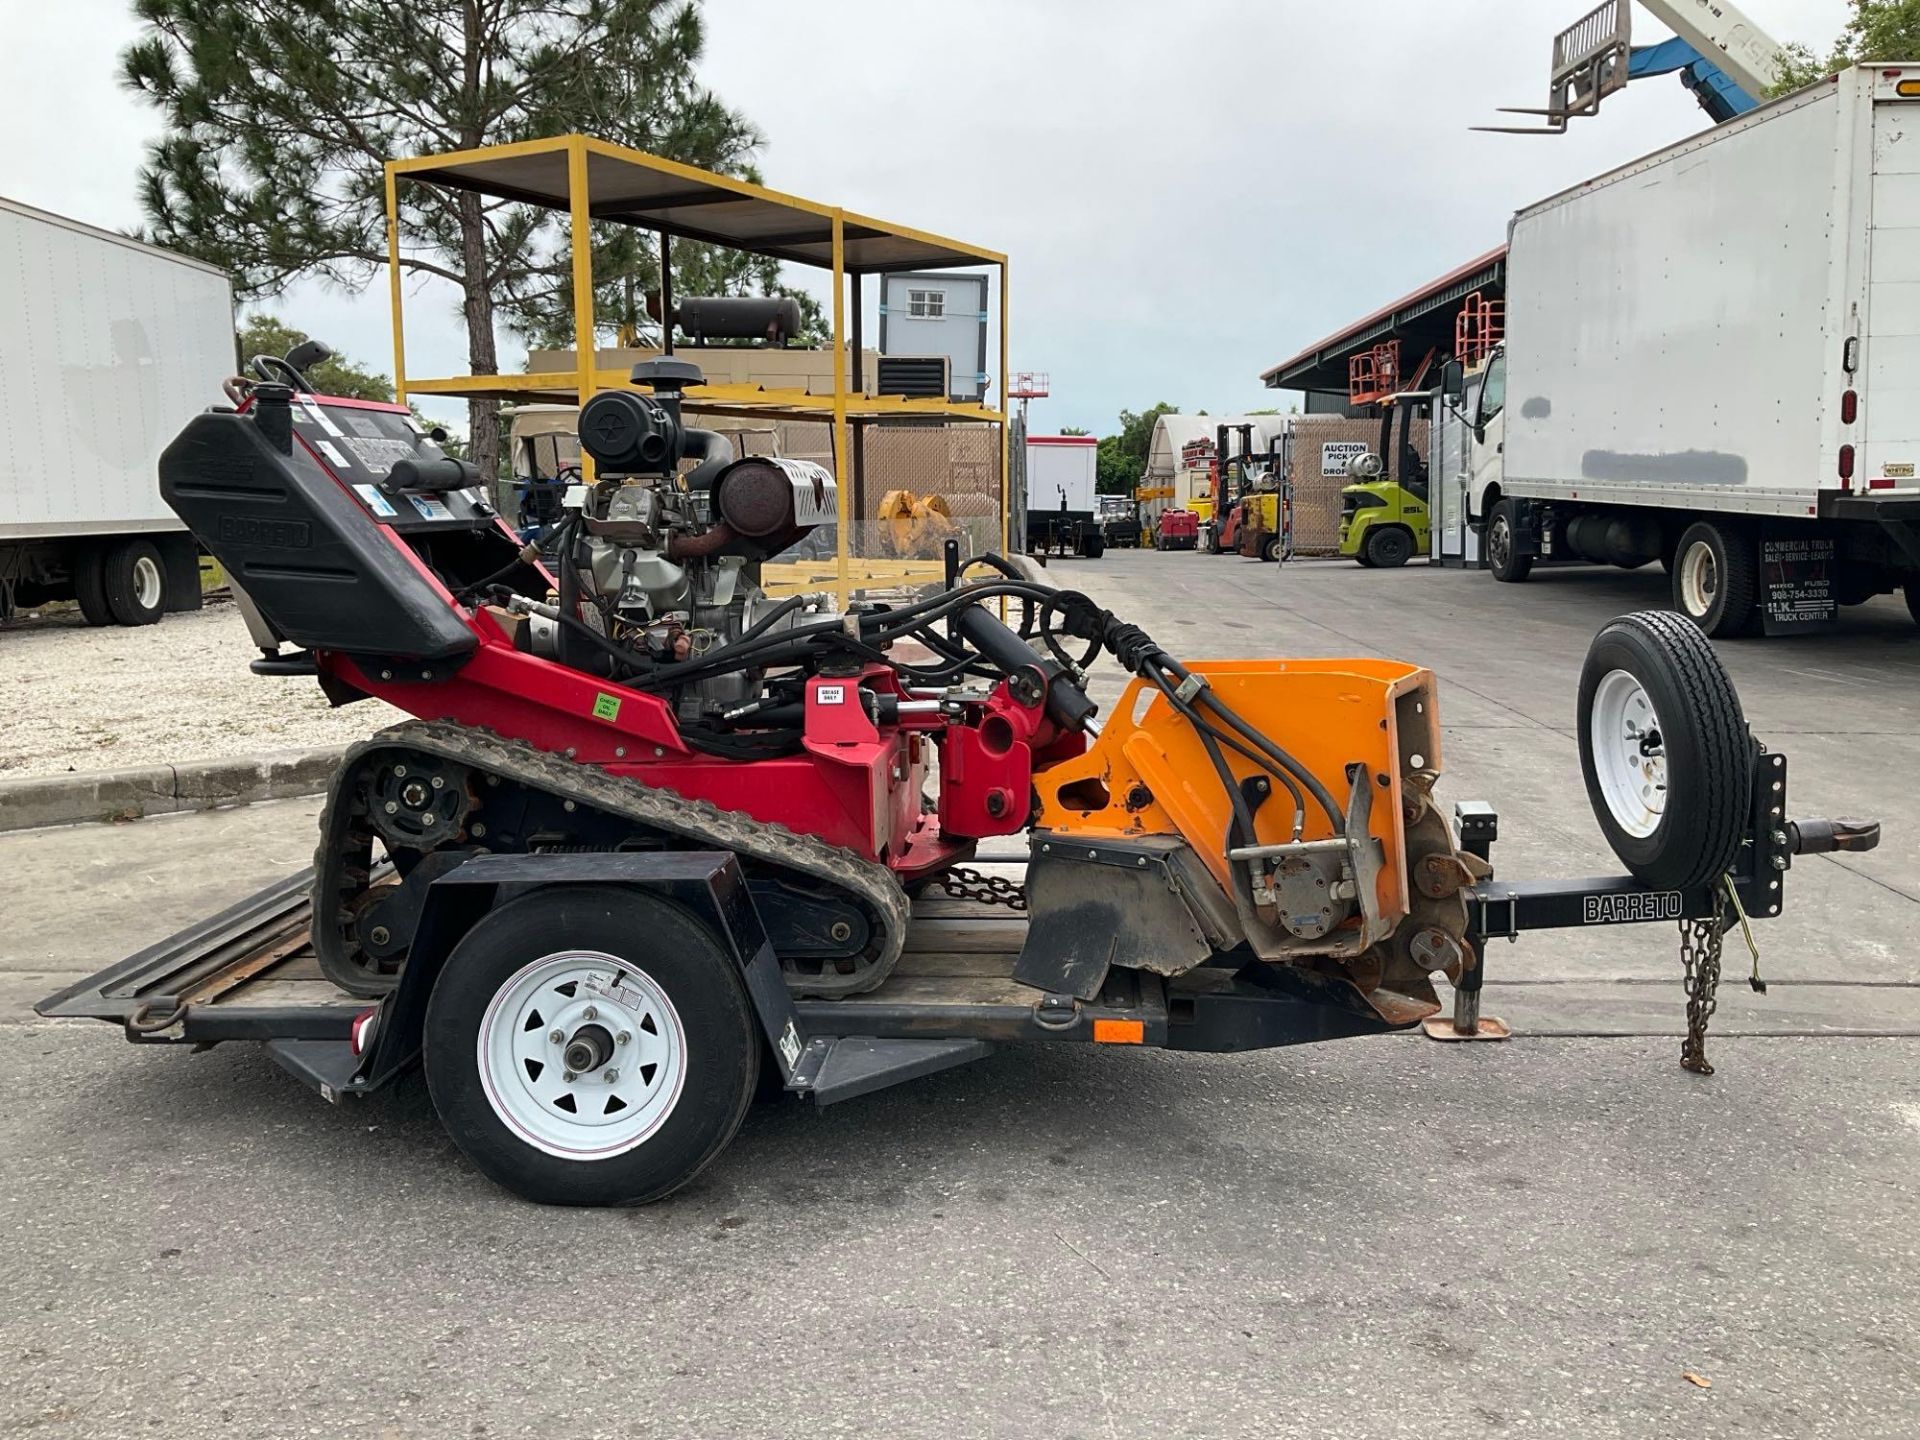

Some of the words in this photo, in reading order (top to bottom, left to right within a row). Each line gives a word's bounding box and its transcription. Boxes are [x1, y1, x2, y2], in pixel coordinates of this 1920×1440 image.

[1324, 444, 1367, 452] AUCTION
[1774, 613, 1798, 622] TRUCK
[1799, 611, 1828, 621] CENTER
[1584, 891, 1682, 923] BARRETO
